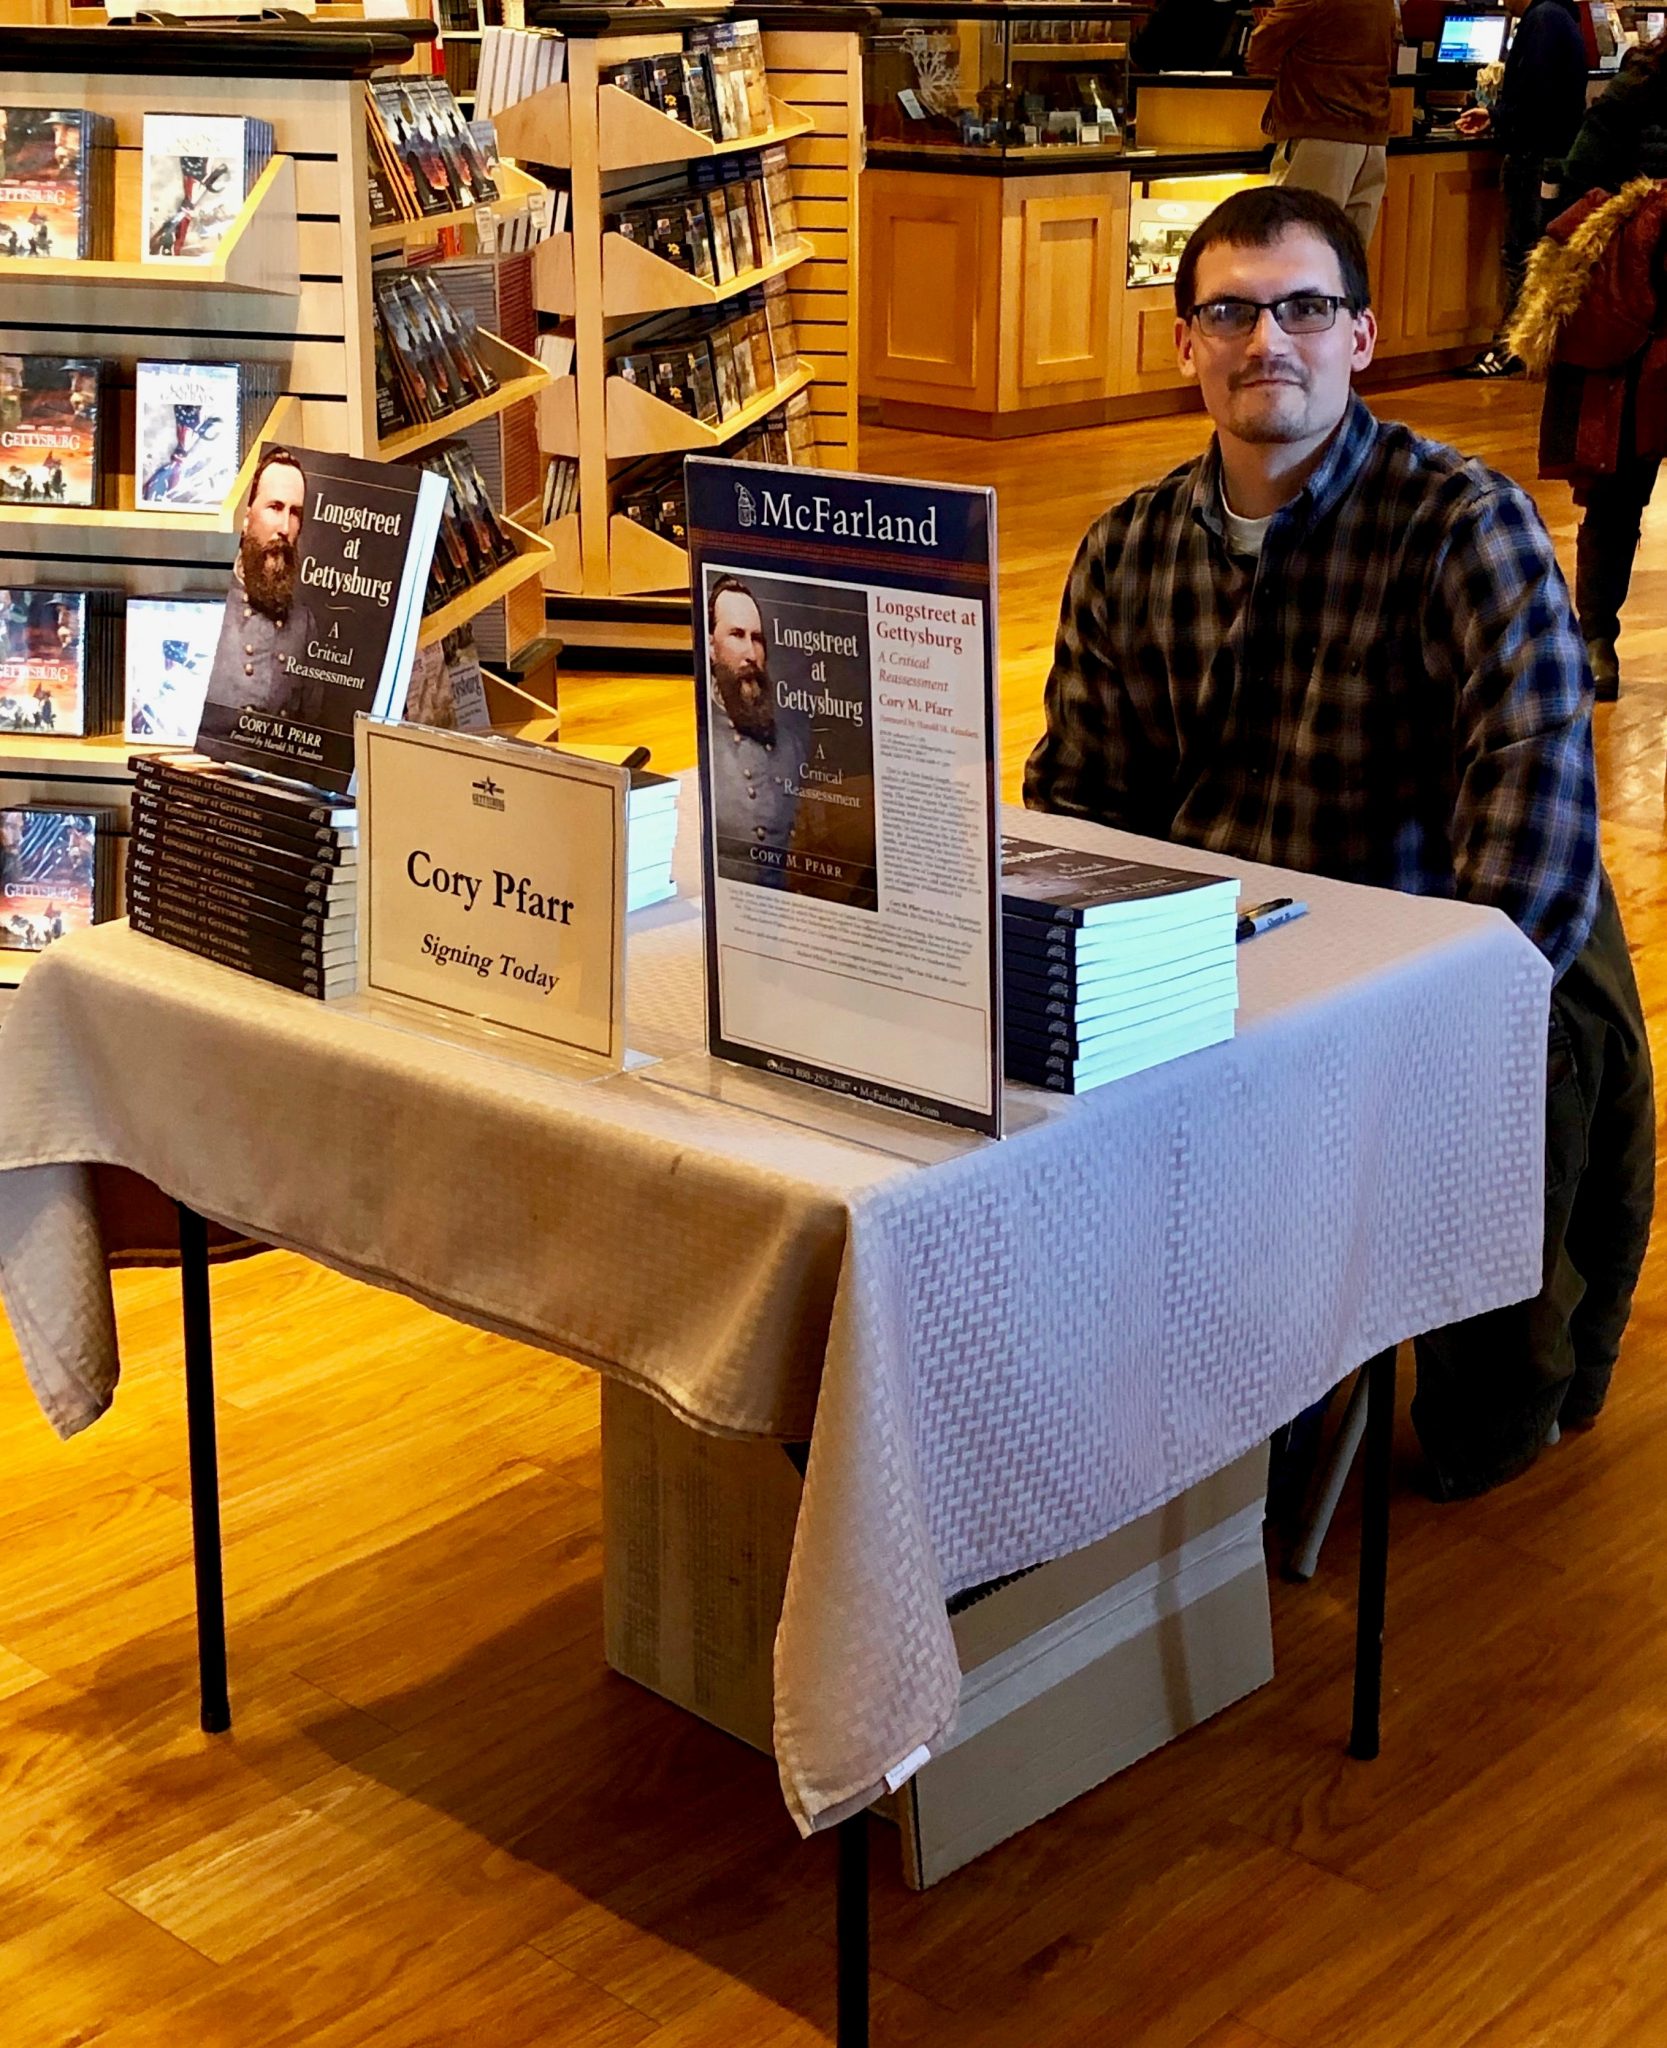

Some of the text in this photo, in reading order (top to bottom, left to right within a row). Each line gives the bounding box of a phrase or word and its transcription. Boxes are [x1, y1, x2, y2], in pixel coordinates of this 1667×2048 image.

[0, 188, 66, 206] ETTYSBURG
[1, 431, 81, 451] GETTYSBURG
[312, 492, 402, 537] Longstreet
[761, 491, 938, 547] McFarland
[343, 538, 360, 560] at
[301, 556, 392, 607] Gettysburg
[876, 596, 976, 626] Longstreet at
[327, 622, 339, 639] A
[773, 618, 859, 658] Longstreet
[876, 621, 963, 655] Gettysburg
[307, 640, 353, 666] Critical
[889, 652, 930, 669] Critical
[285, 656, 365, 690] Reassessment
[811, 660, 826, 682] at
[777, 680, 863, 727] Gettysburg
[239, 715, 270, 734] CORY
[287, 727, 322, 748] PFARR
[815, 743, 826, 760] A
[799, 762, 843, 785] Critical
[784, 778, 860, 808] Reassessment
[749, 846, 782, 865] CORY
[805, 859, 842, 878] PFARR
[407, 850, 574, 925] Cory Pfarr
[421, 933, 560, 995] Signing Today
[860, 1085, 940, 1118] McFarlandPub.com
